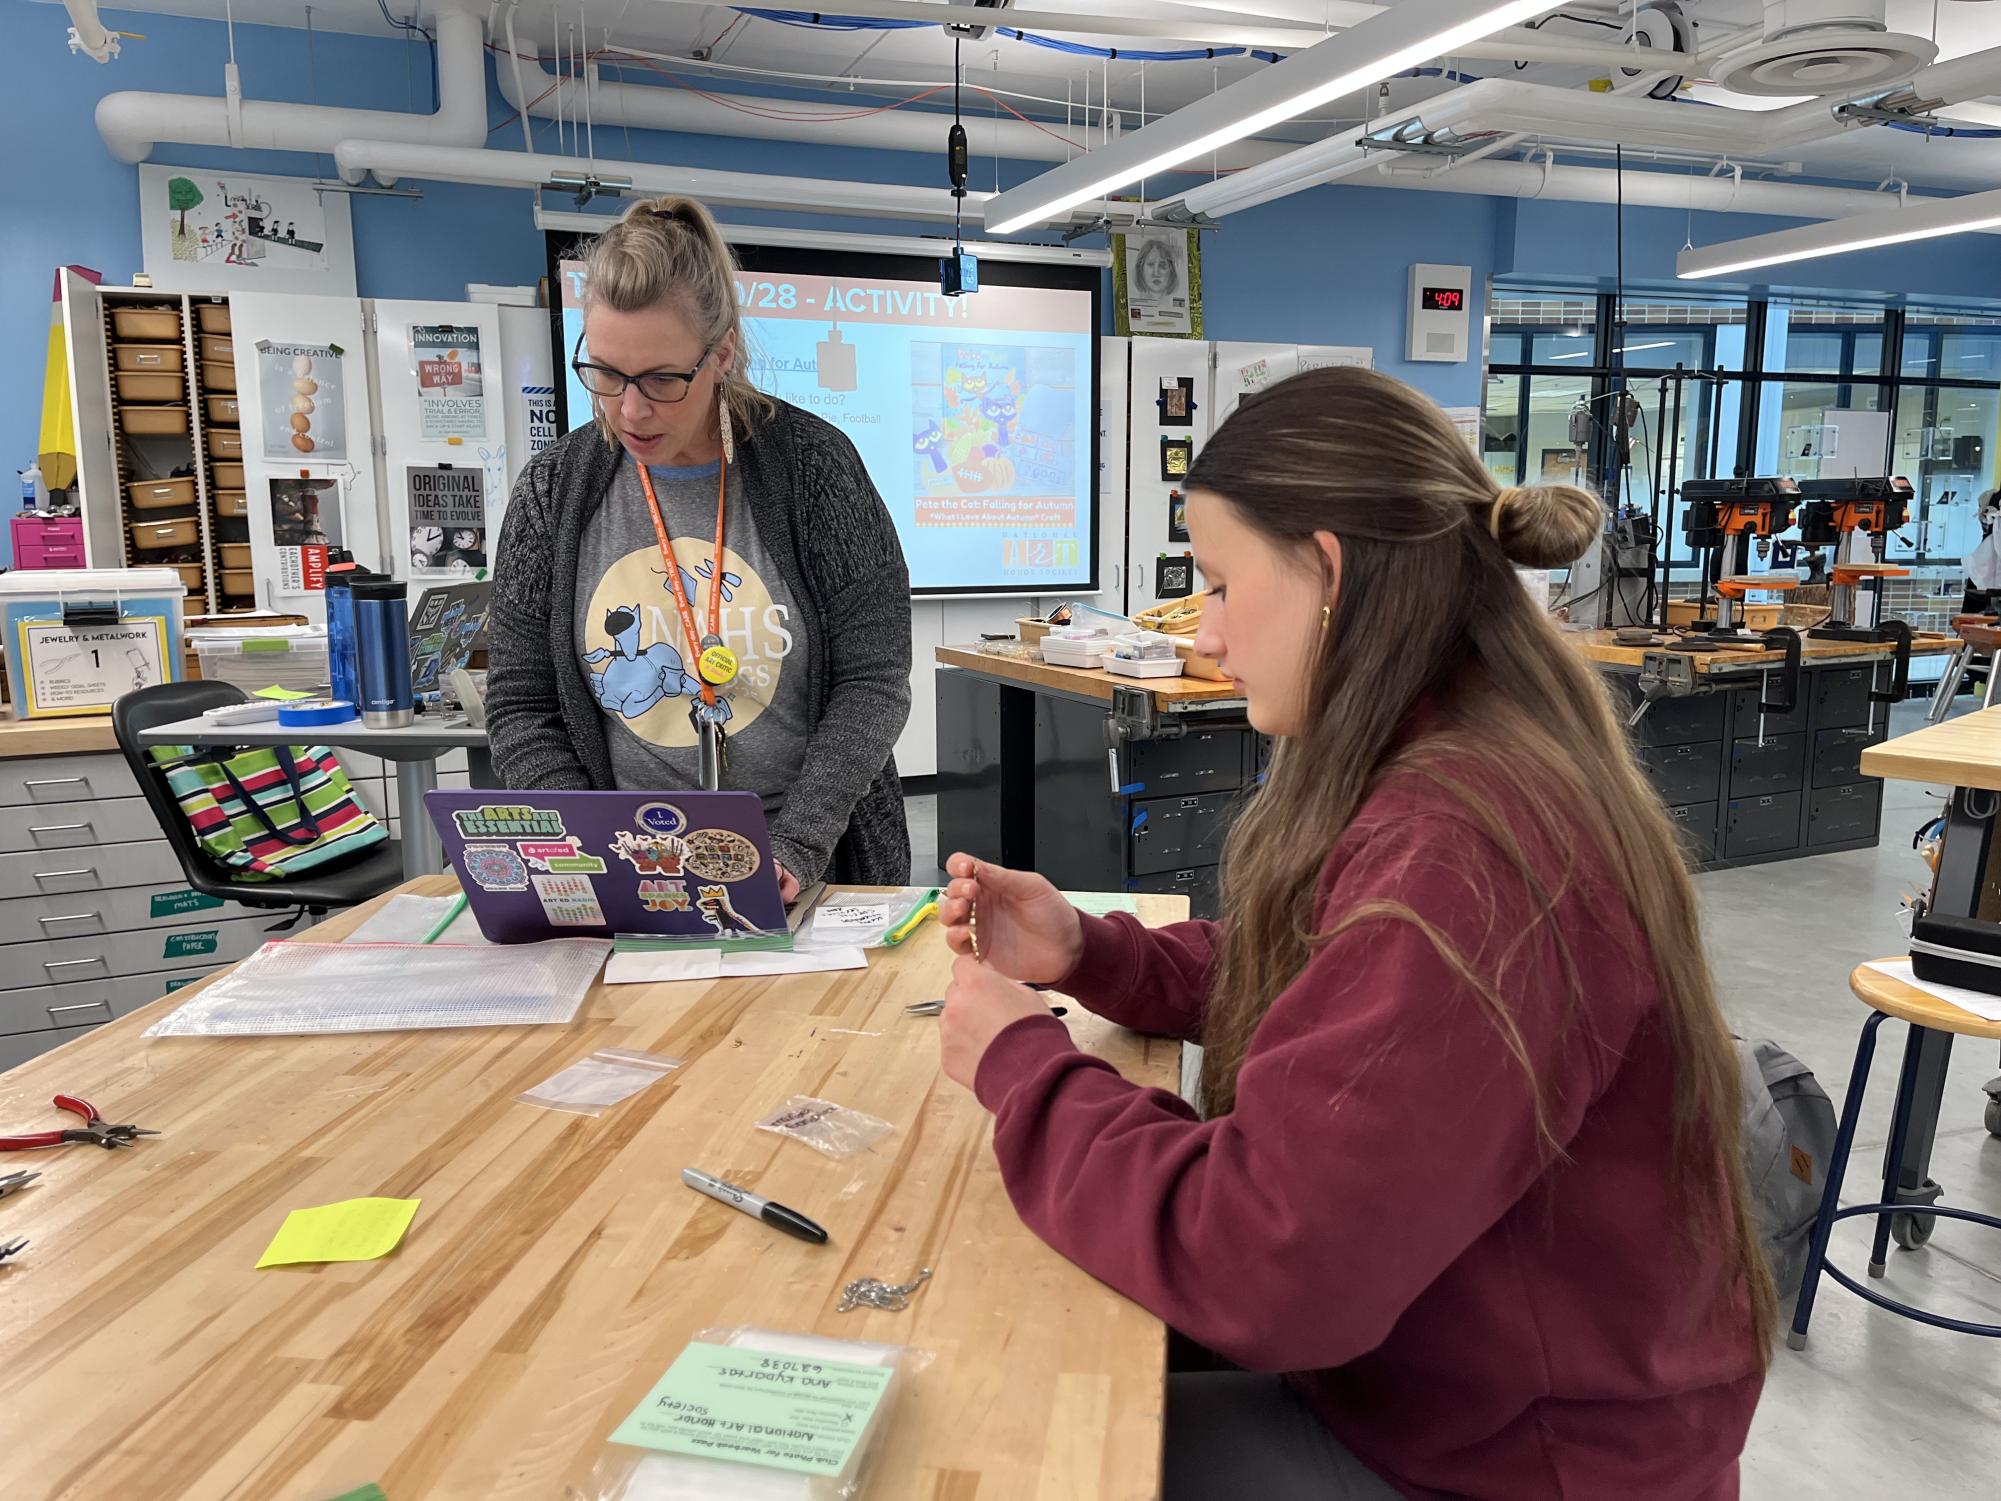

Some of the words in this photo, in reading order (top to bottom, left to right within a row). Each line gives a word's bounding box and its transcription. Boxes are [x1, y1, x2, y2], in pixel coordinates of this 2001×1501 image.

[824, 286, 969, 318] ACTIVITY!
[1435, 292, 1460, 306] 4:09
[414, 333, 478, 343] INNOVATION
[260, 346, 291, 356] BEING
[424, 364, 459, 374] WRONG
[772, 357, 790, 368] for
[793, 358, 818, 370] Aut
[432, 375, 453, 384] WAY
[786, 393, 806, 404] like
[809, 394, 822, 404] to
[824, 394, 846, 406] do?
[530, 410, 556, 424] NO
[843, 412, 880, 424] Football
[530, 426, 554, 437] CELL
[413, 474, 480, 492] ORIGINAL
[414, 494, 448, 508] IDEAS
[451, 494, 480, 509] TAKE
[916, 500, 938, 509] Pete
[942, 500, 958, 509] the
[983, 500, 1016, 511] Falling
[1019, 500, 1033, 510] for
[1036, 501, 1074, 510] Autumn
[415, 510, 434, 520] TIME
[437, 510, 448, 520] TO
[450, 510, 481, 521] EVOLVE
[279, 548, 290, 590] CONTRIBUTIONS
[308, 548, 324, 588] AMPLIFY
[40, 635, 79, 644] JEWELRY
[91, 632, 148, 641] METALWORK
[91, 649, 100, 668] 1
[711, 650, 733, 666] OFFICIAL
[705, 656, 715, 665] ART
[716, 662, 733, 674] CRITIC
[460, 812, 484, 821] THE
[484, 807, 532, 820] ARTS
[532, 812, 558, 821] ARE
[463, 821, 562, 833] ESSENTIAL
[648, 817, 677, 826] Voted
[640, 880, 686, 892] ART
[174, 899, 200, 909] MATS
[760, 1358, 823, 1374] 627038
[801, 1378, 832, 1389] Ana
[674, 1415, 716, 1428] Honor
[720, 1420, 745, 1432] Art
[748, 1424, 814, 1441] National
[691, 1438, 714, 1447] Pass
[717, 1442, 761, 1454] Yearbook
[783, 1452, 813, 1462] Photo
[815, 1457, 839, 1465] Club
